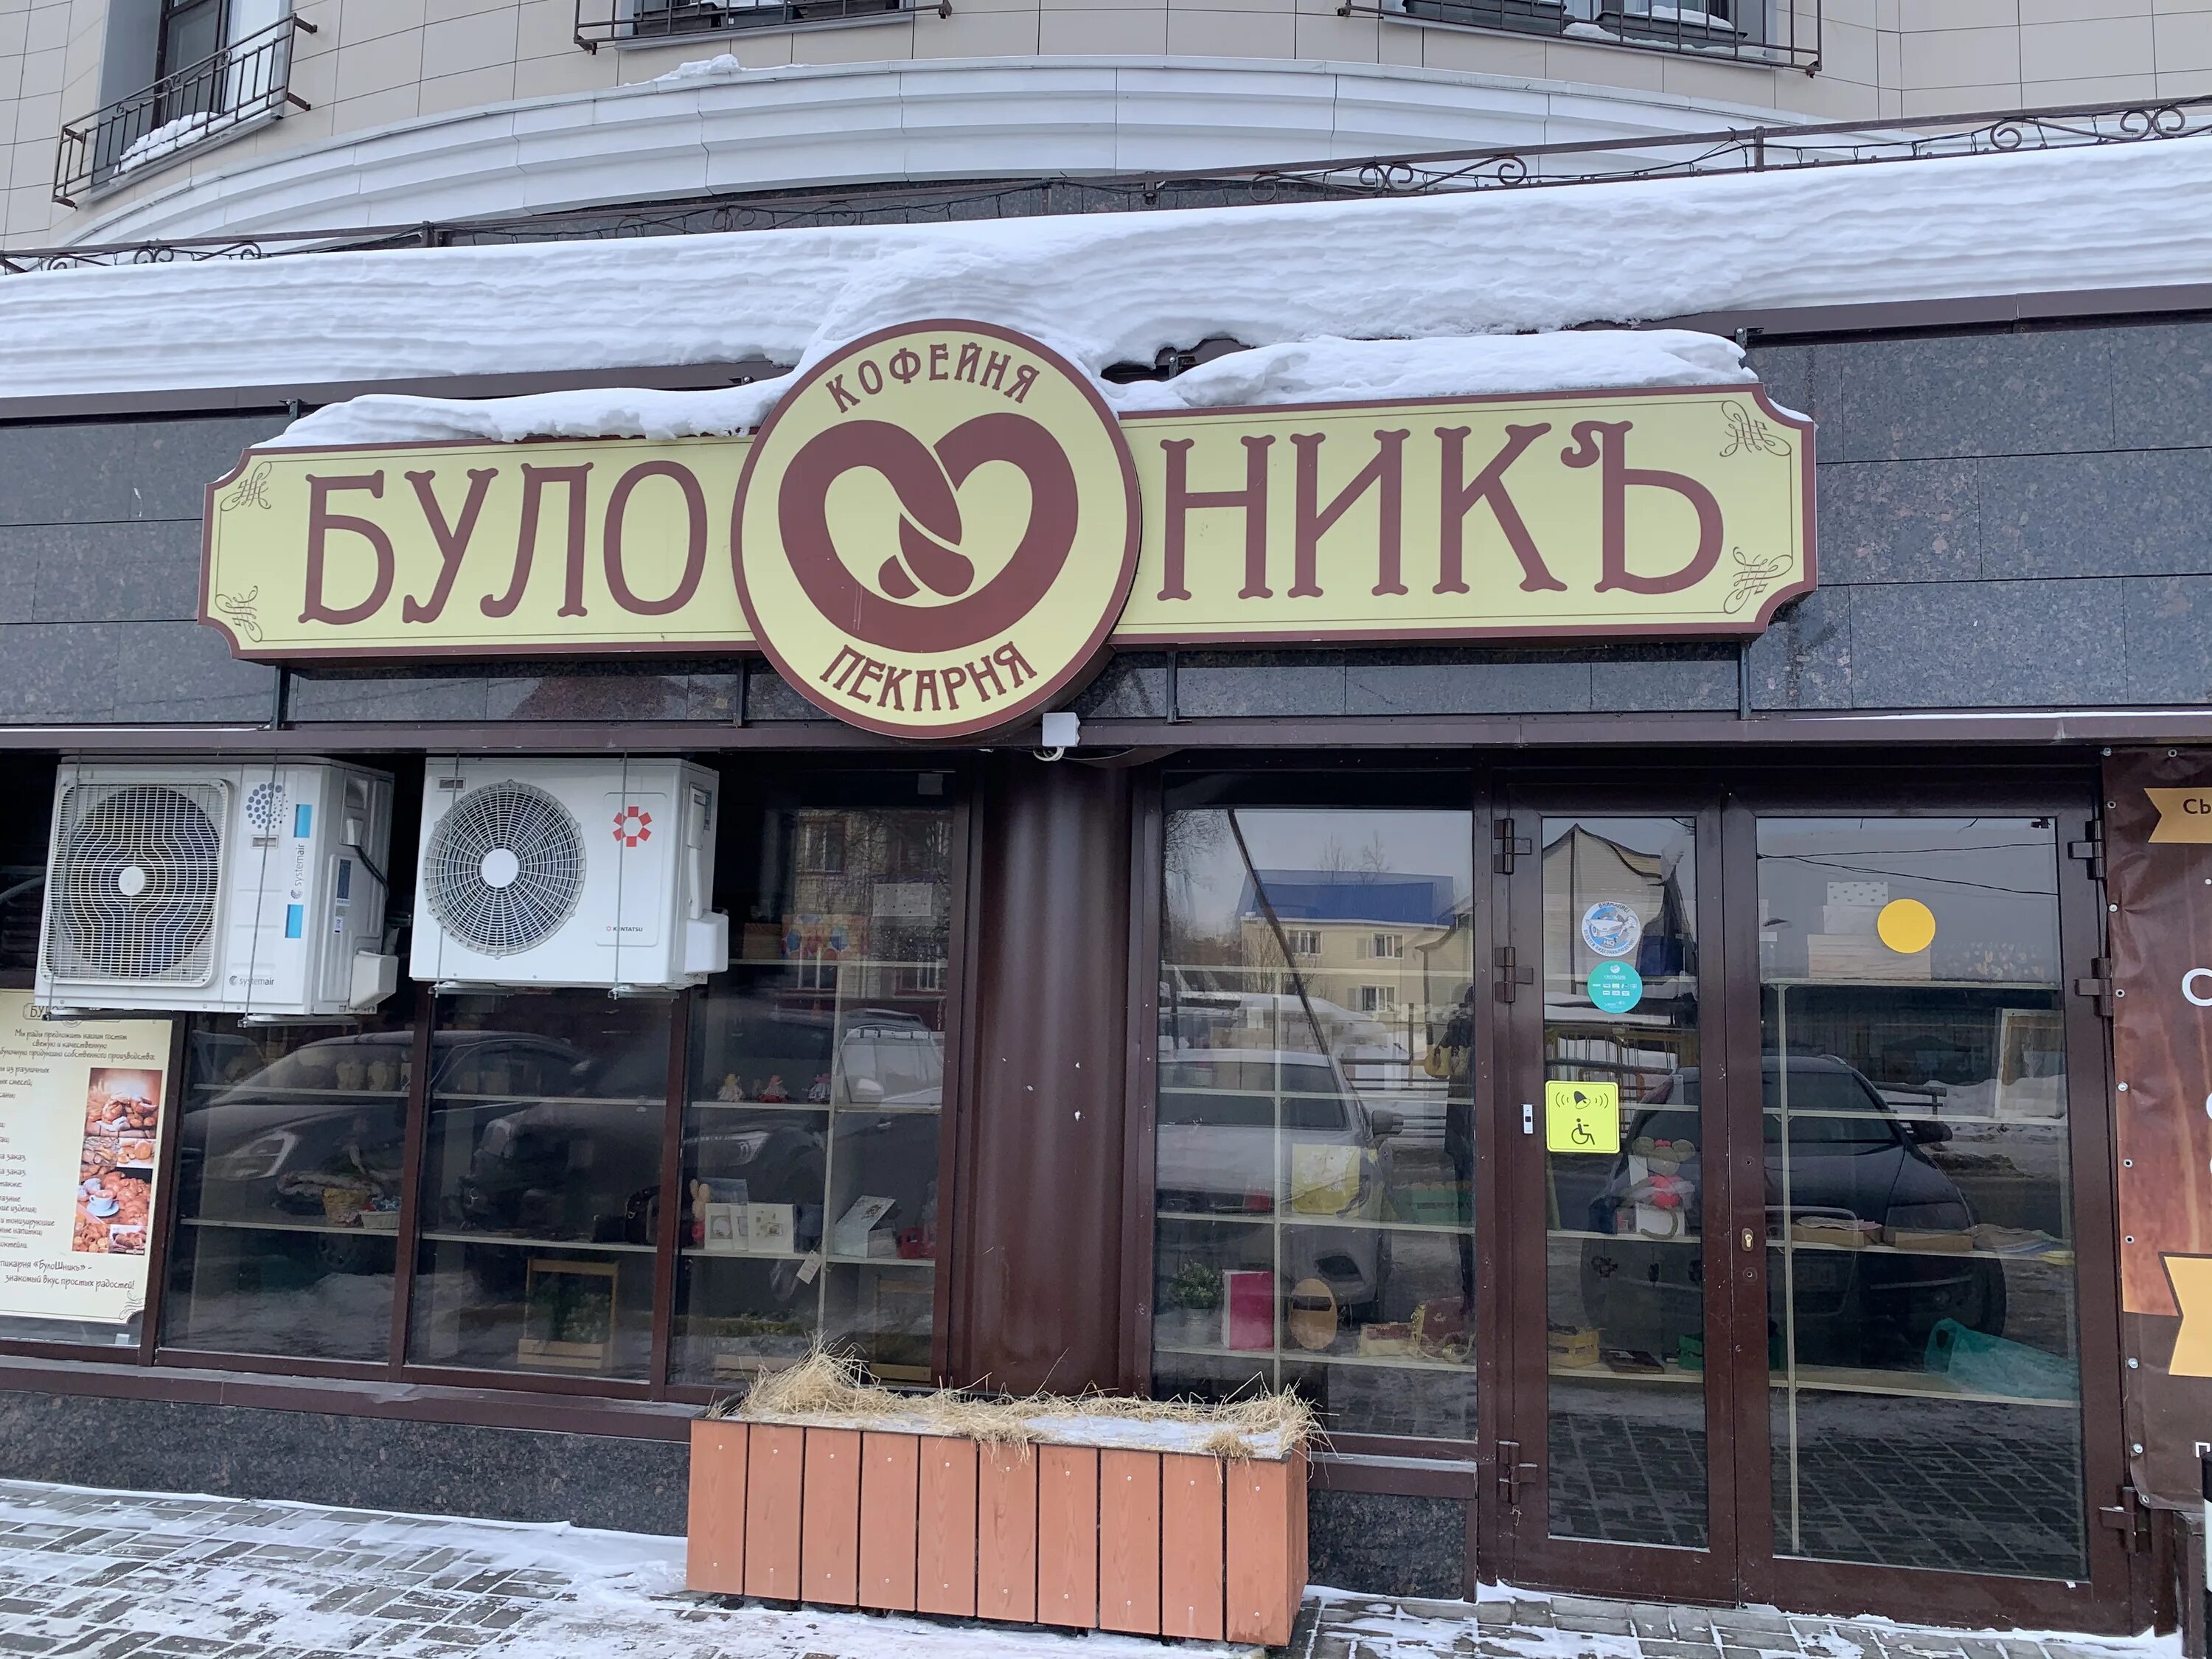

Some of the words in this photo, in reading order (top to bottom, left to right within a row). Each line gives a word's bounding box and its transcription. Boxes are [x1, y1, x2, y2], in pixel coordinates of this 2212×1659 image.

[826, 342, 1040, 413] КОФЕЙНЯ
[298, 460, 708, 625] БУЛО
[1157, 420, 1724, 601] НИКЪ
[820, 641, 1037, 712] ПЕКАРНЯ
[295, 844, 305, 886] systemair
[1599, 902, 1630, 914] ВНИМАНИЕ!
[43, 1274, 60, 1288] вкус
